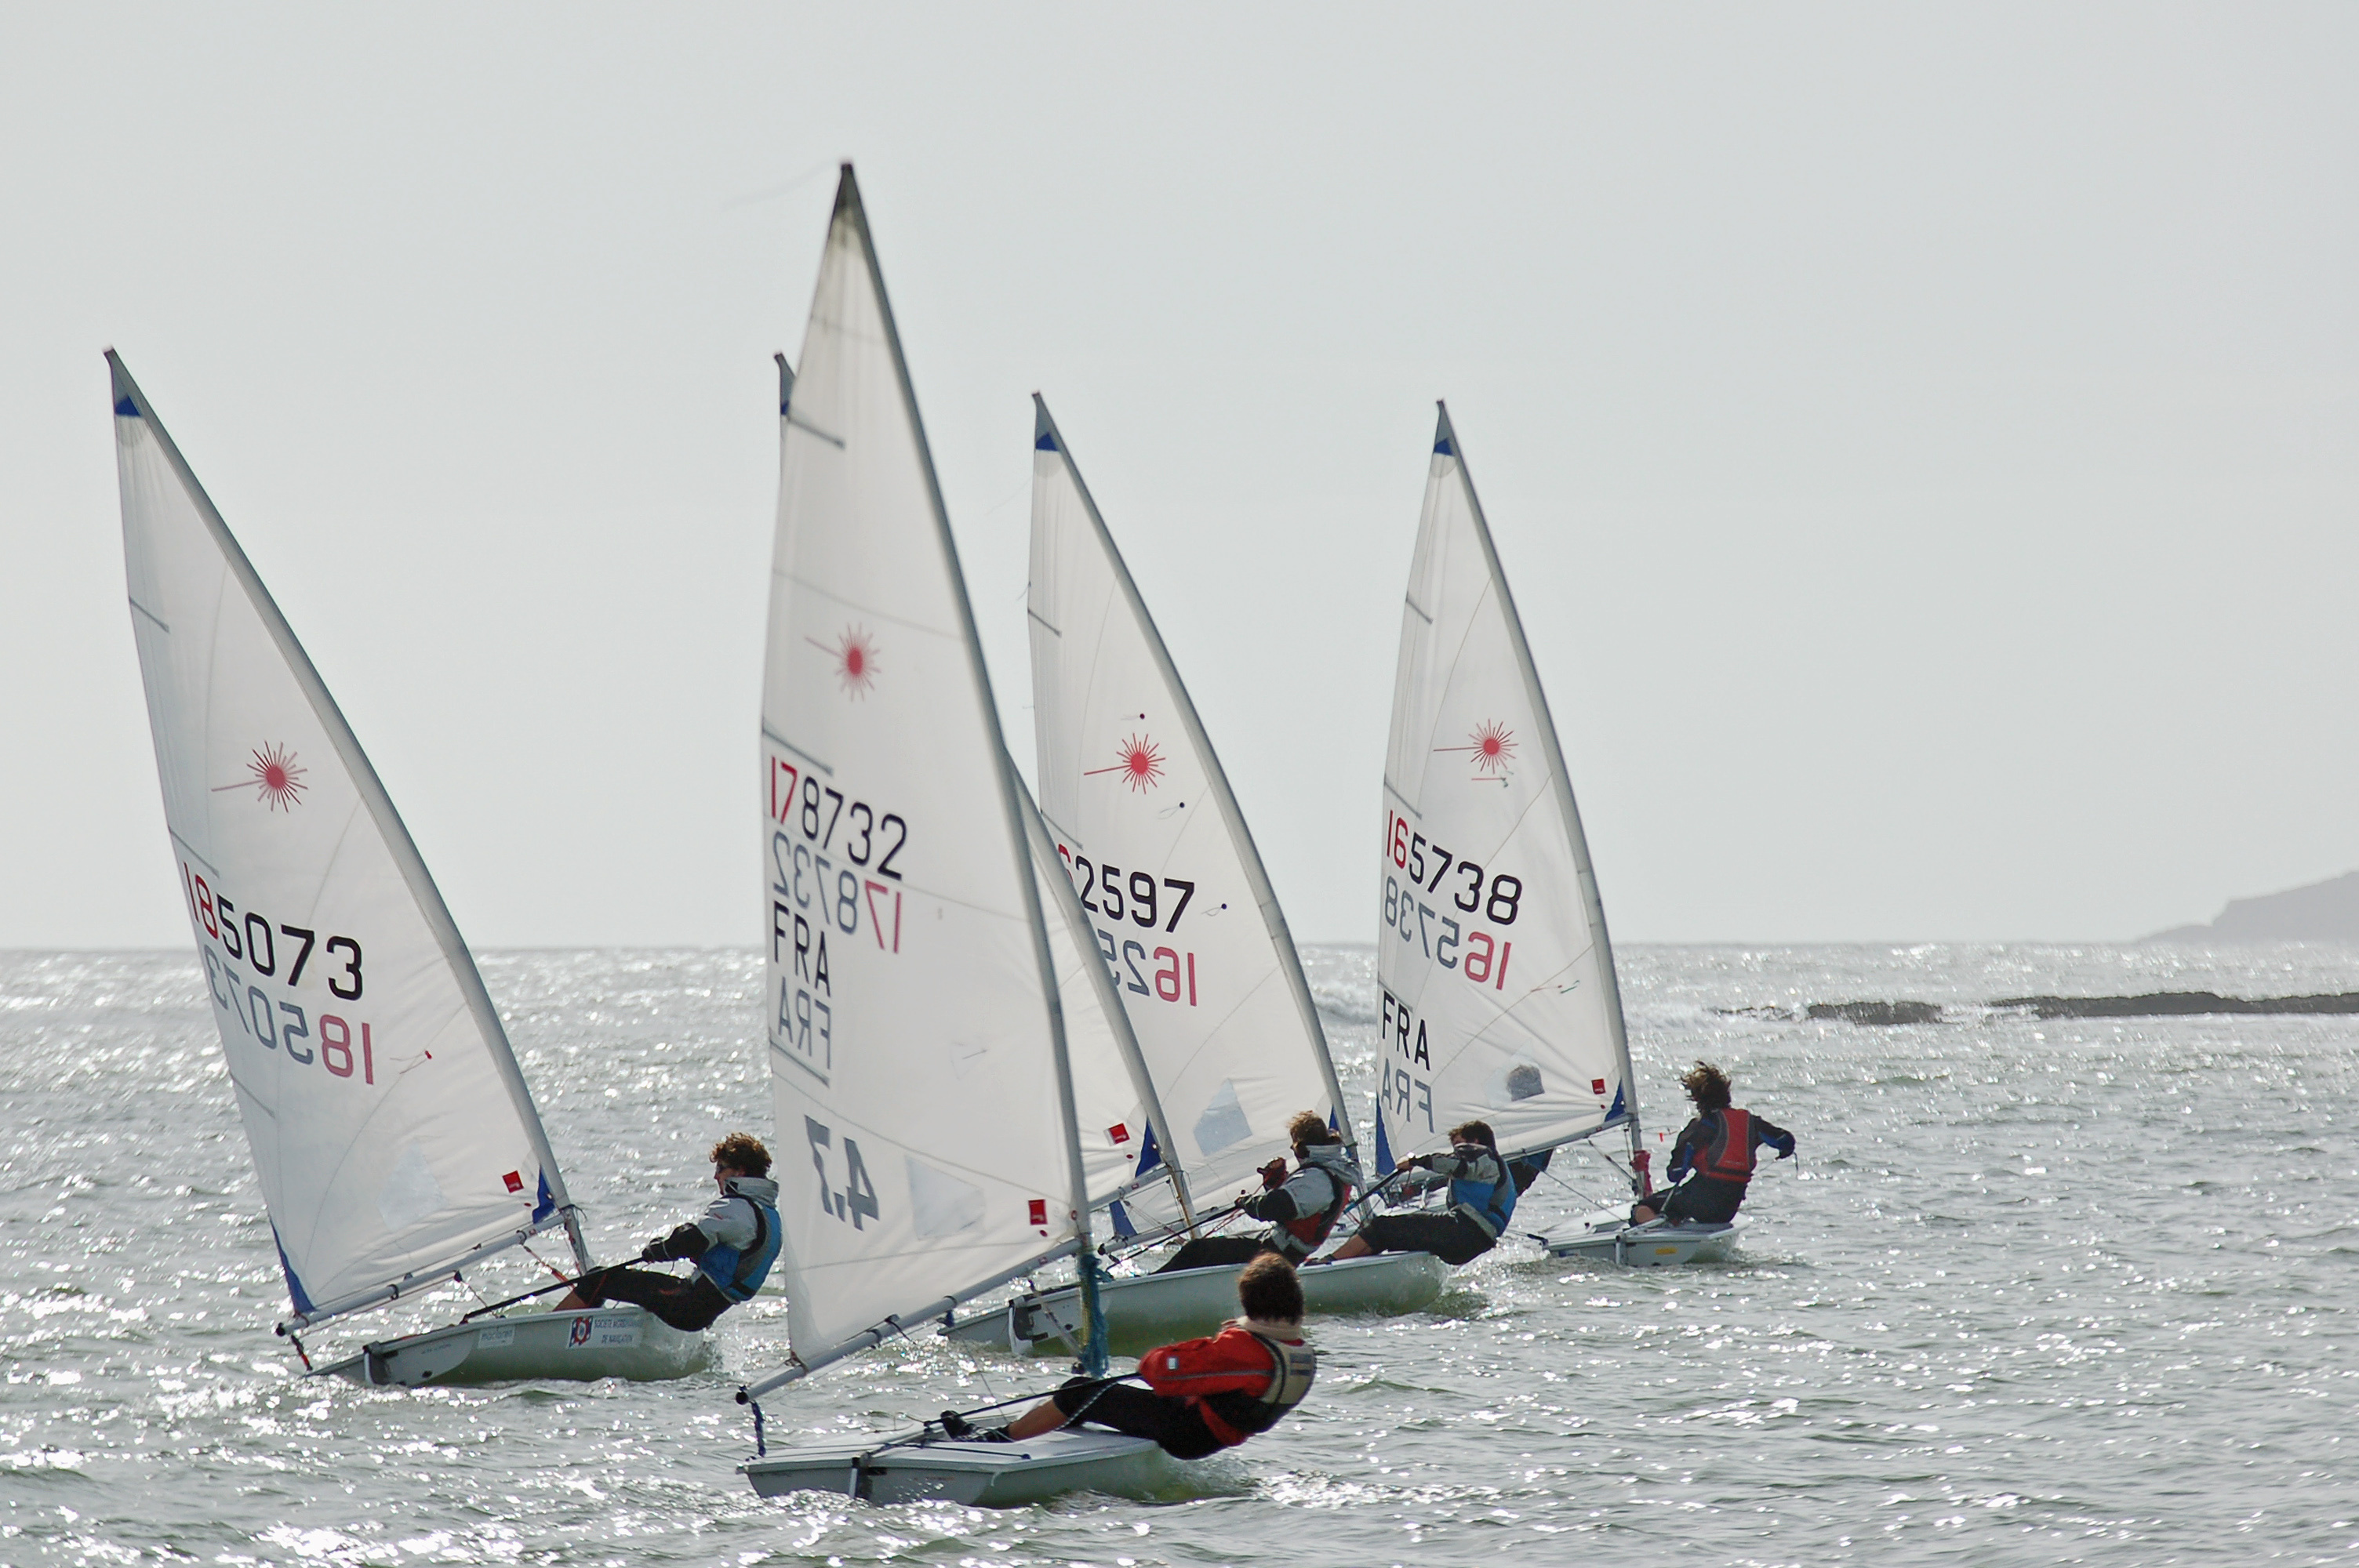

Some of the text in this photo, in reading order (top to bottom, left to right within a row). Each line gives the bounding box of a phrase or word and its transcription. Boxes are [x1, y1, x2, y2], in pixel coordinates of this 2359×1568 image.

[772, 756, 907, 880] 178732
[1386, 809, 1522, 925] 165738
[183, 862, 363, 1000] 185073
[1059, 844, 1194, 932] 2597
[773, 900, 831, 997] FRA
[1382, 990, 1430, 1071] FRA
